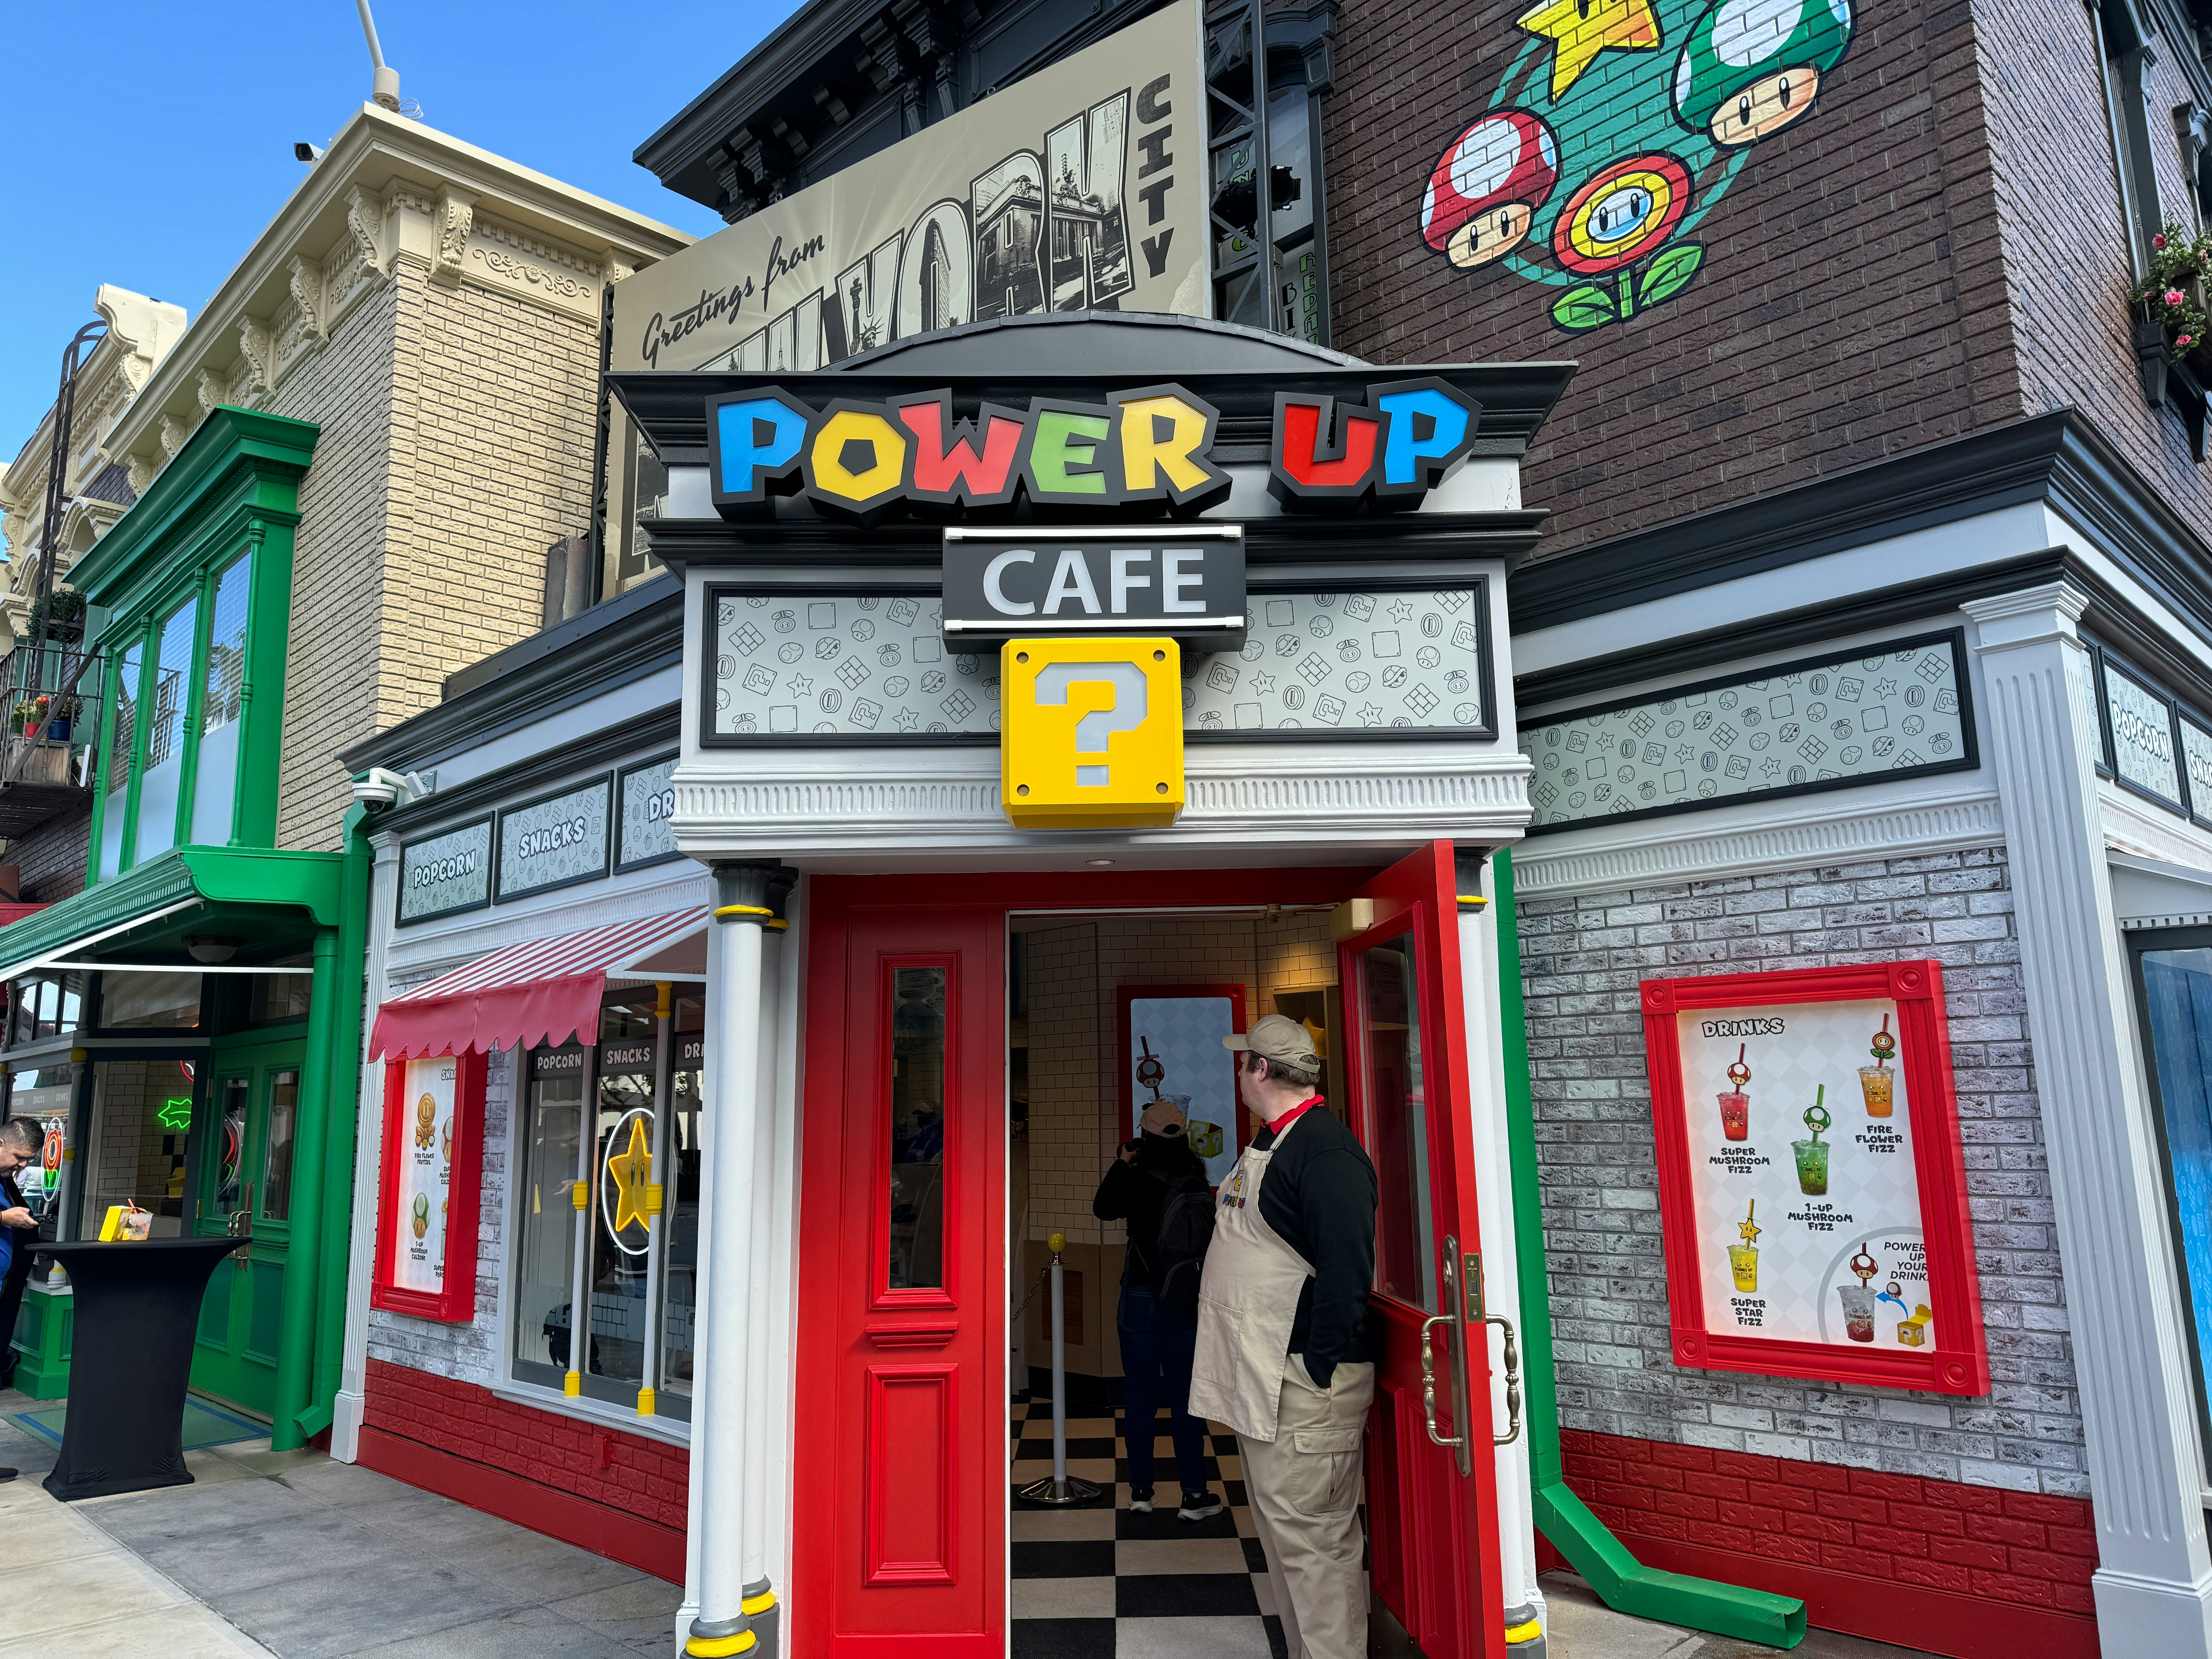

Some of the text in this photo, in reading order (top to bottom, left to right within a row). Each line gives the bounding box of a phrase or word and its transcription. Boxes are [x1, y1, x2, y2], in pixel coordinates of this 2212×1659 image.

[1135, 73, 1174, 278] CITY
[642, 275, 755, 369] Greetings
[761, 235, 825, 312] from
[707, 379, 1482, 515] POWER UP
[982, 548, 1207, 616] CAFE
[2111, 700, 2169, 763] POPCORN
[519, 815, 586, 860] SNACKS
[414, 848, 477, 890] POPCORN
[1701, 1017, 1785, 1038] DRINKS
[606, 1047, 651, 1065] SNACKS
[538, 1053, 582, 1070] POPCORN
[1866, 1125, 1893, 1134] FIRE
[1855, 1135, 1903, 1144] FLOWER
[1721, 1147, 1756, 1156] SUPER
[1868, 1144, 1896, 1153] FIZZ
[1709, 1156, 1770, 1165] MUSHROOM
[1728, 1166, 1752, 1174] FIZZ
[1805, 1203, 1833, 1212] 1-UP
[1788, 1212, 1853, 1223] MUSHROOM
[1808, 1222, 1834, 1231] FIZZ
[1884, 1242, 1925, 1252] POWER
[1909, 1253, 1925, 1261] UP
[1897, 1262, 1928, 1271] YOUR
[1730, 1298, 1766, 1308] SUPER
[1735, 1307, 1763, 1317] STAR
[1738, 1317, 1762, 1326] FIZZ
